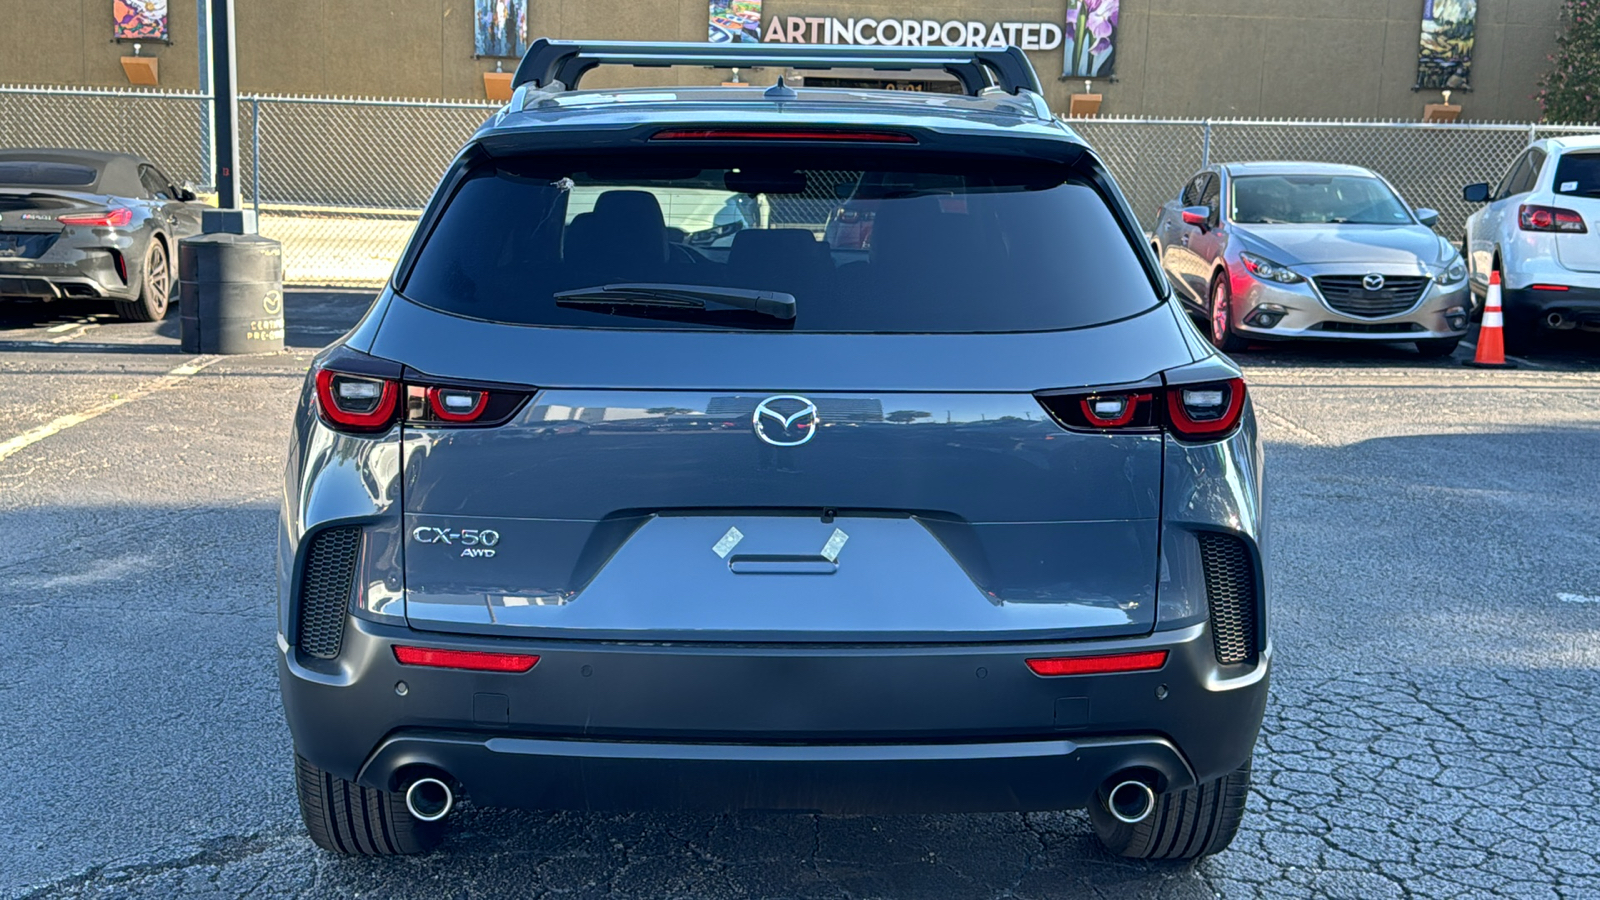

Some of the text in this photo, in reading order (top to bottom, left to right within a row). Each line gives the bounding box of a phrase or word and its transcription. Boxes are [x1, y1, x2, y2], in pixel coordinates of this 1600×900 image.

[763, 15, 1063, 50] ARTINCORPORATED
[412, 526, 500, 547] CX-50
[460, 547, 497, 558] AWD
